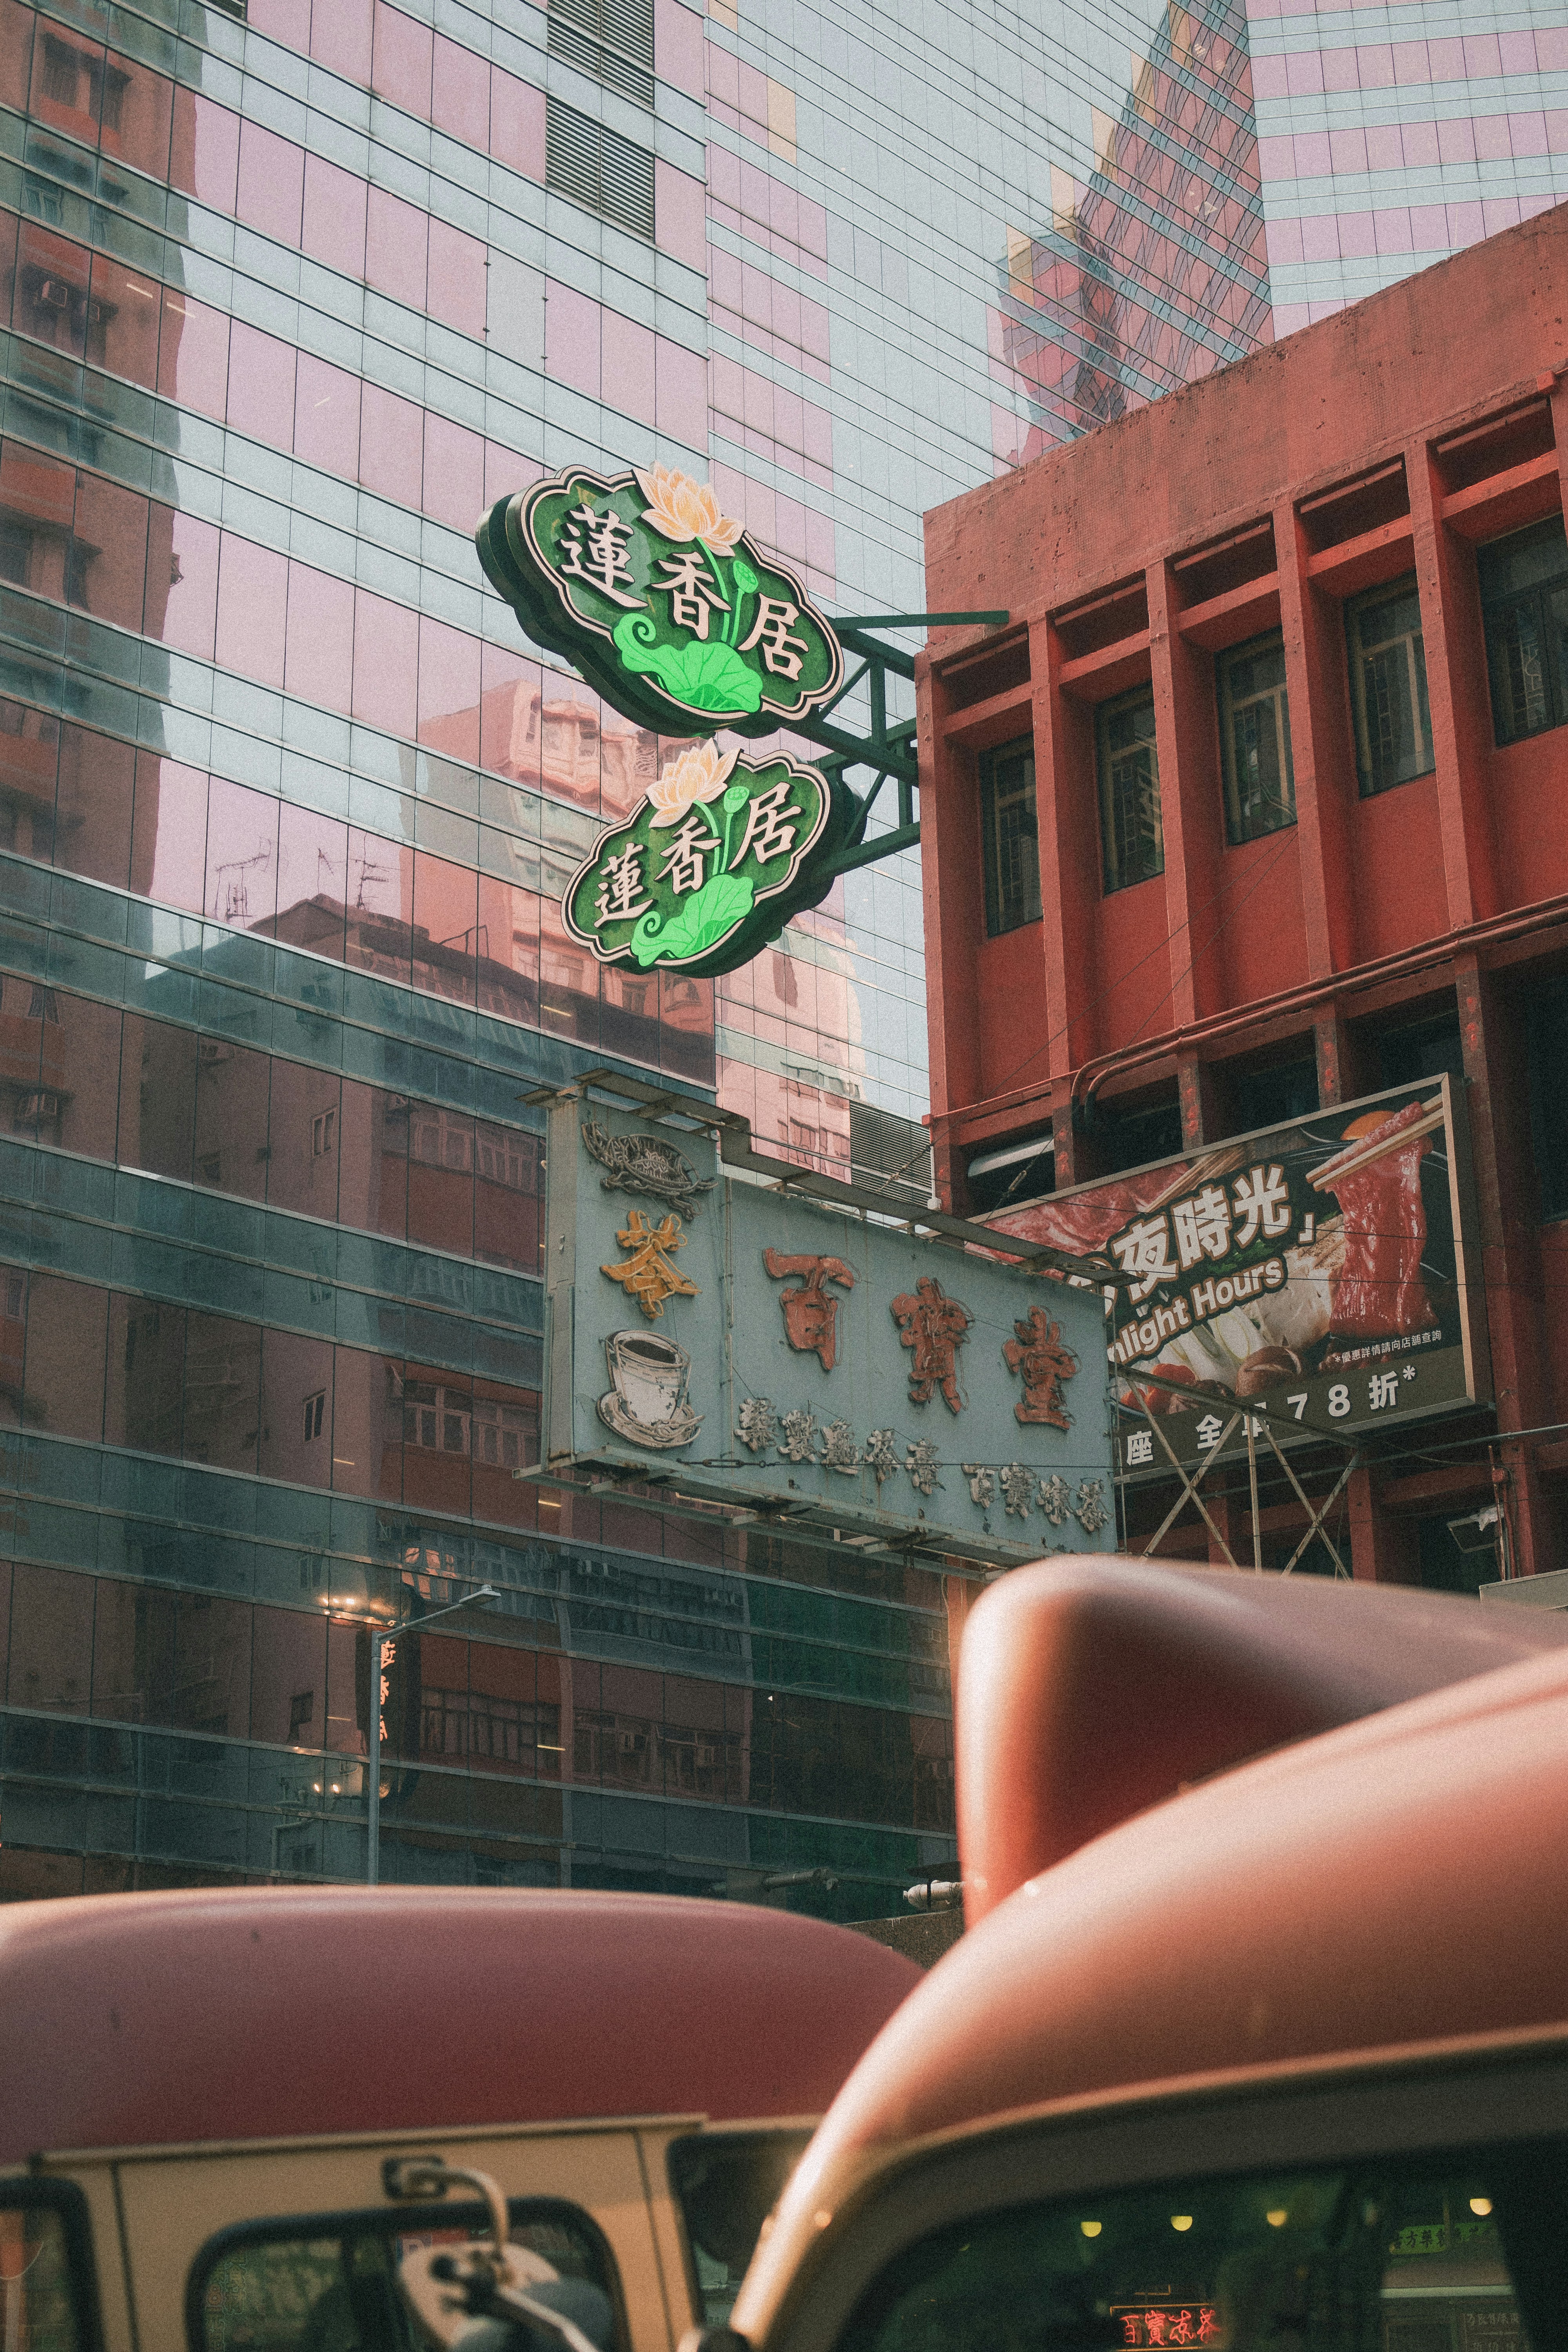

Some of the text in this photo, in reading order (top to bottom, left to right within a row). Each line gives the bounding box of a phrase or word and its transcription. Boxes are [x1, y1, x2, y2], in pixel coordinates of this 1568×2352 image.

[561, 503, 809, 681] 蓮香居
[594, 782, 802, 928] 蓮香居
[600, 1210, 703, 1319] 茶
[1068, 1167, 1313, 1314] 夜時光」
[1193, 1261, 1281, 1316] Hours
